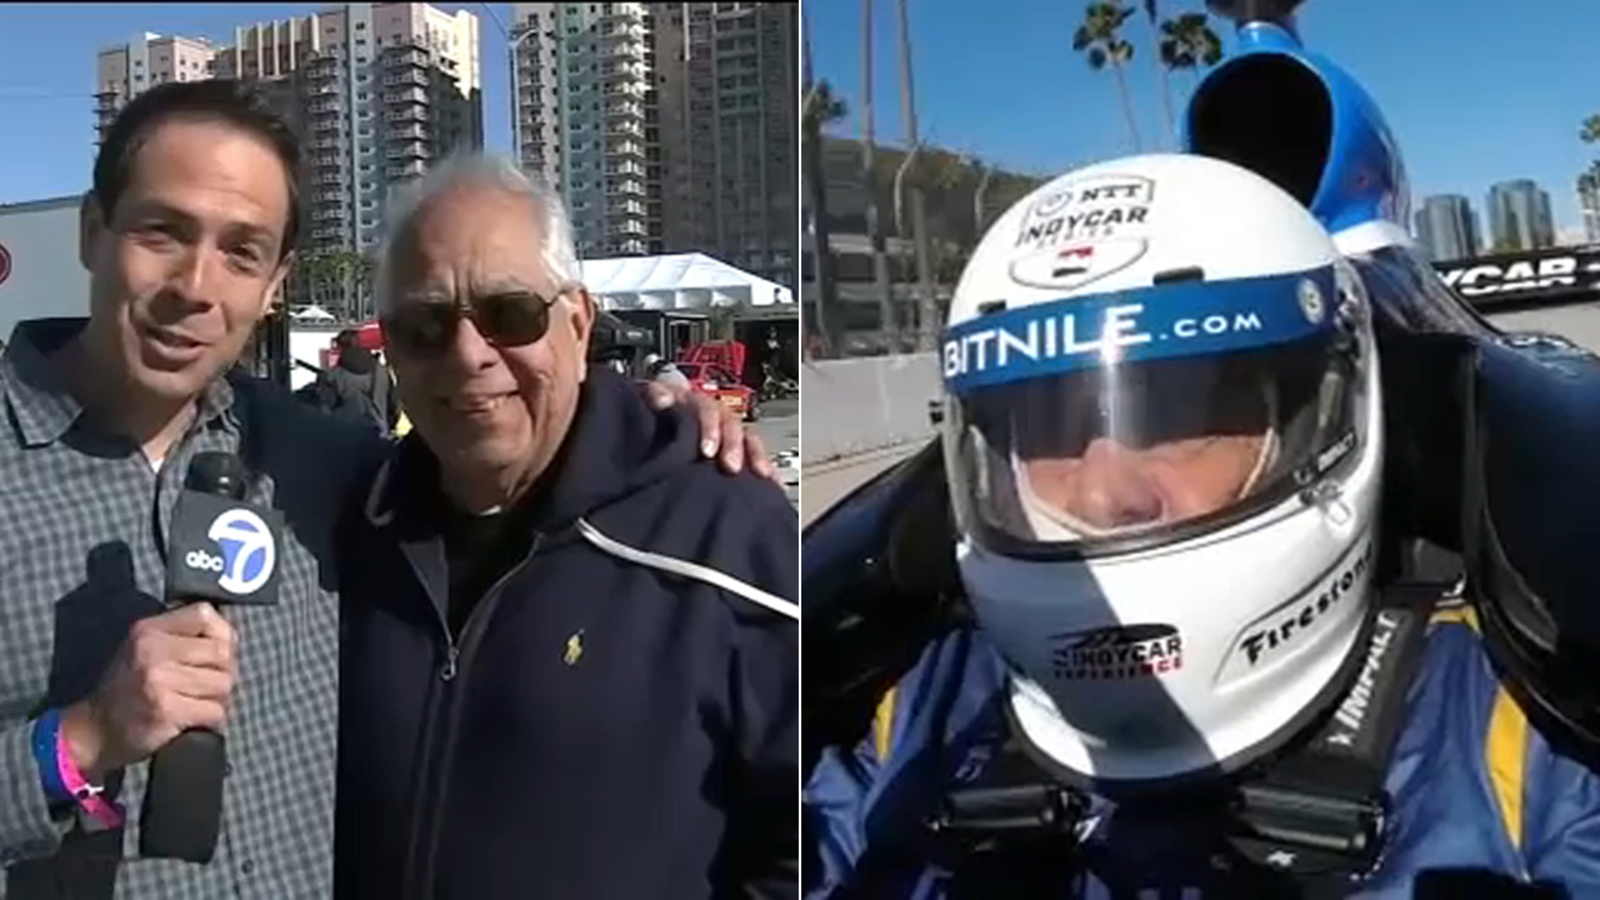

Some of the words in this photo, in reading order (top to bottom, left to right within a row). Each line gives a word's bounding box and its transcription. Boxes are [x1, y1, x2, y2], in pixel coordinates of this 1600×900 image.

[1081, 183, 1142, 203] NTT
[1014, 206, 1149, 248] INDYCAR
[185, 549, 225, 573] abc
[208, 508, 275, 595] 7
[1072, 635, 1182, 667] INDYCAR
